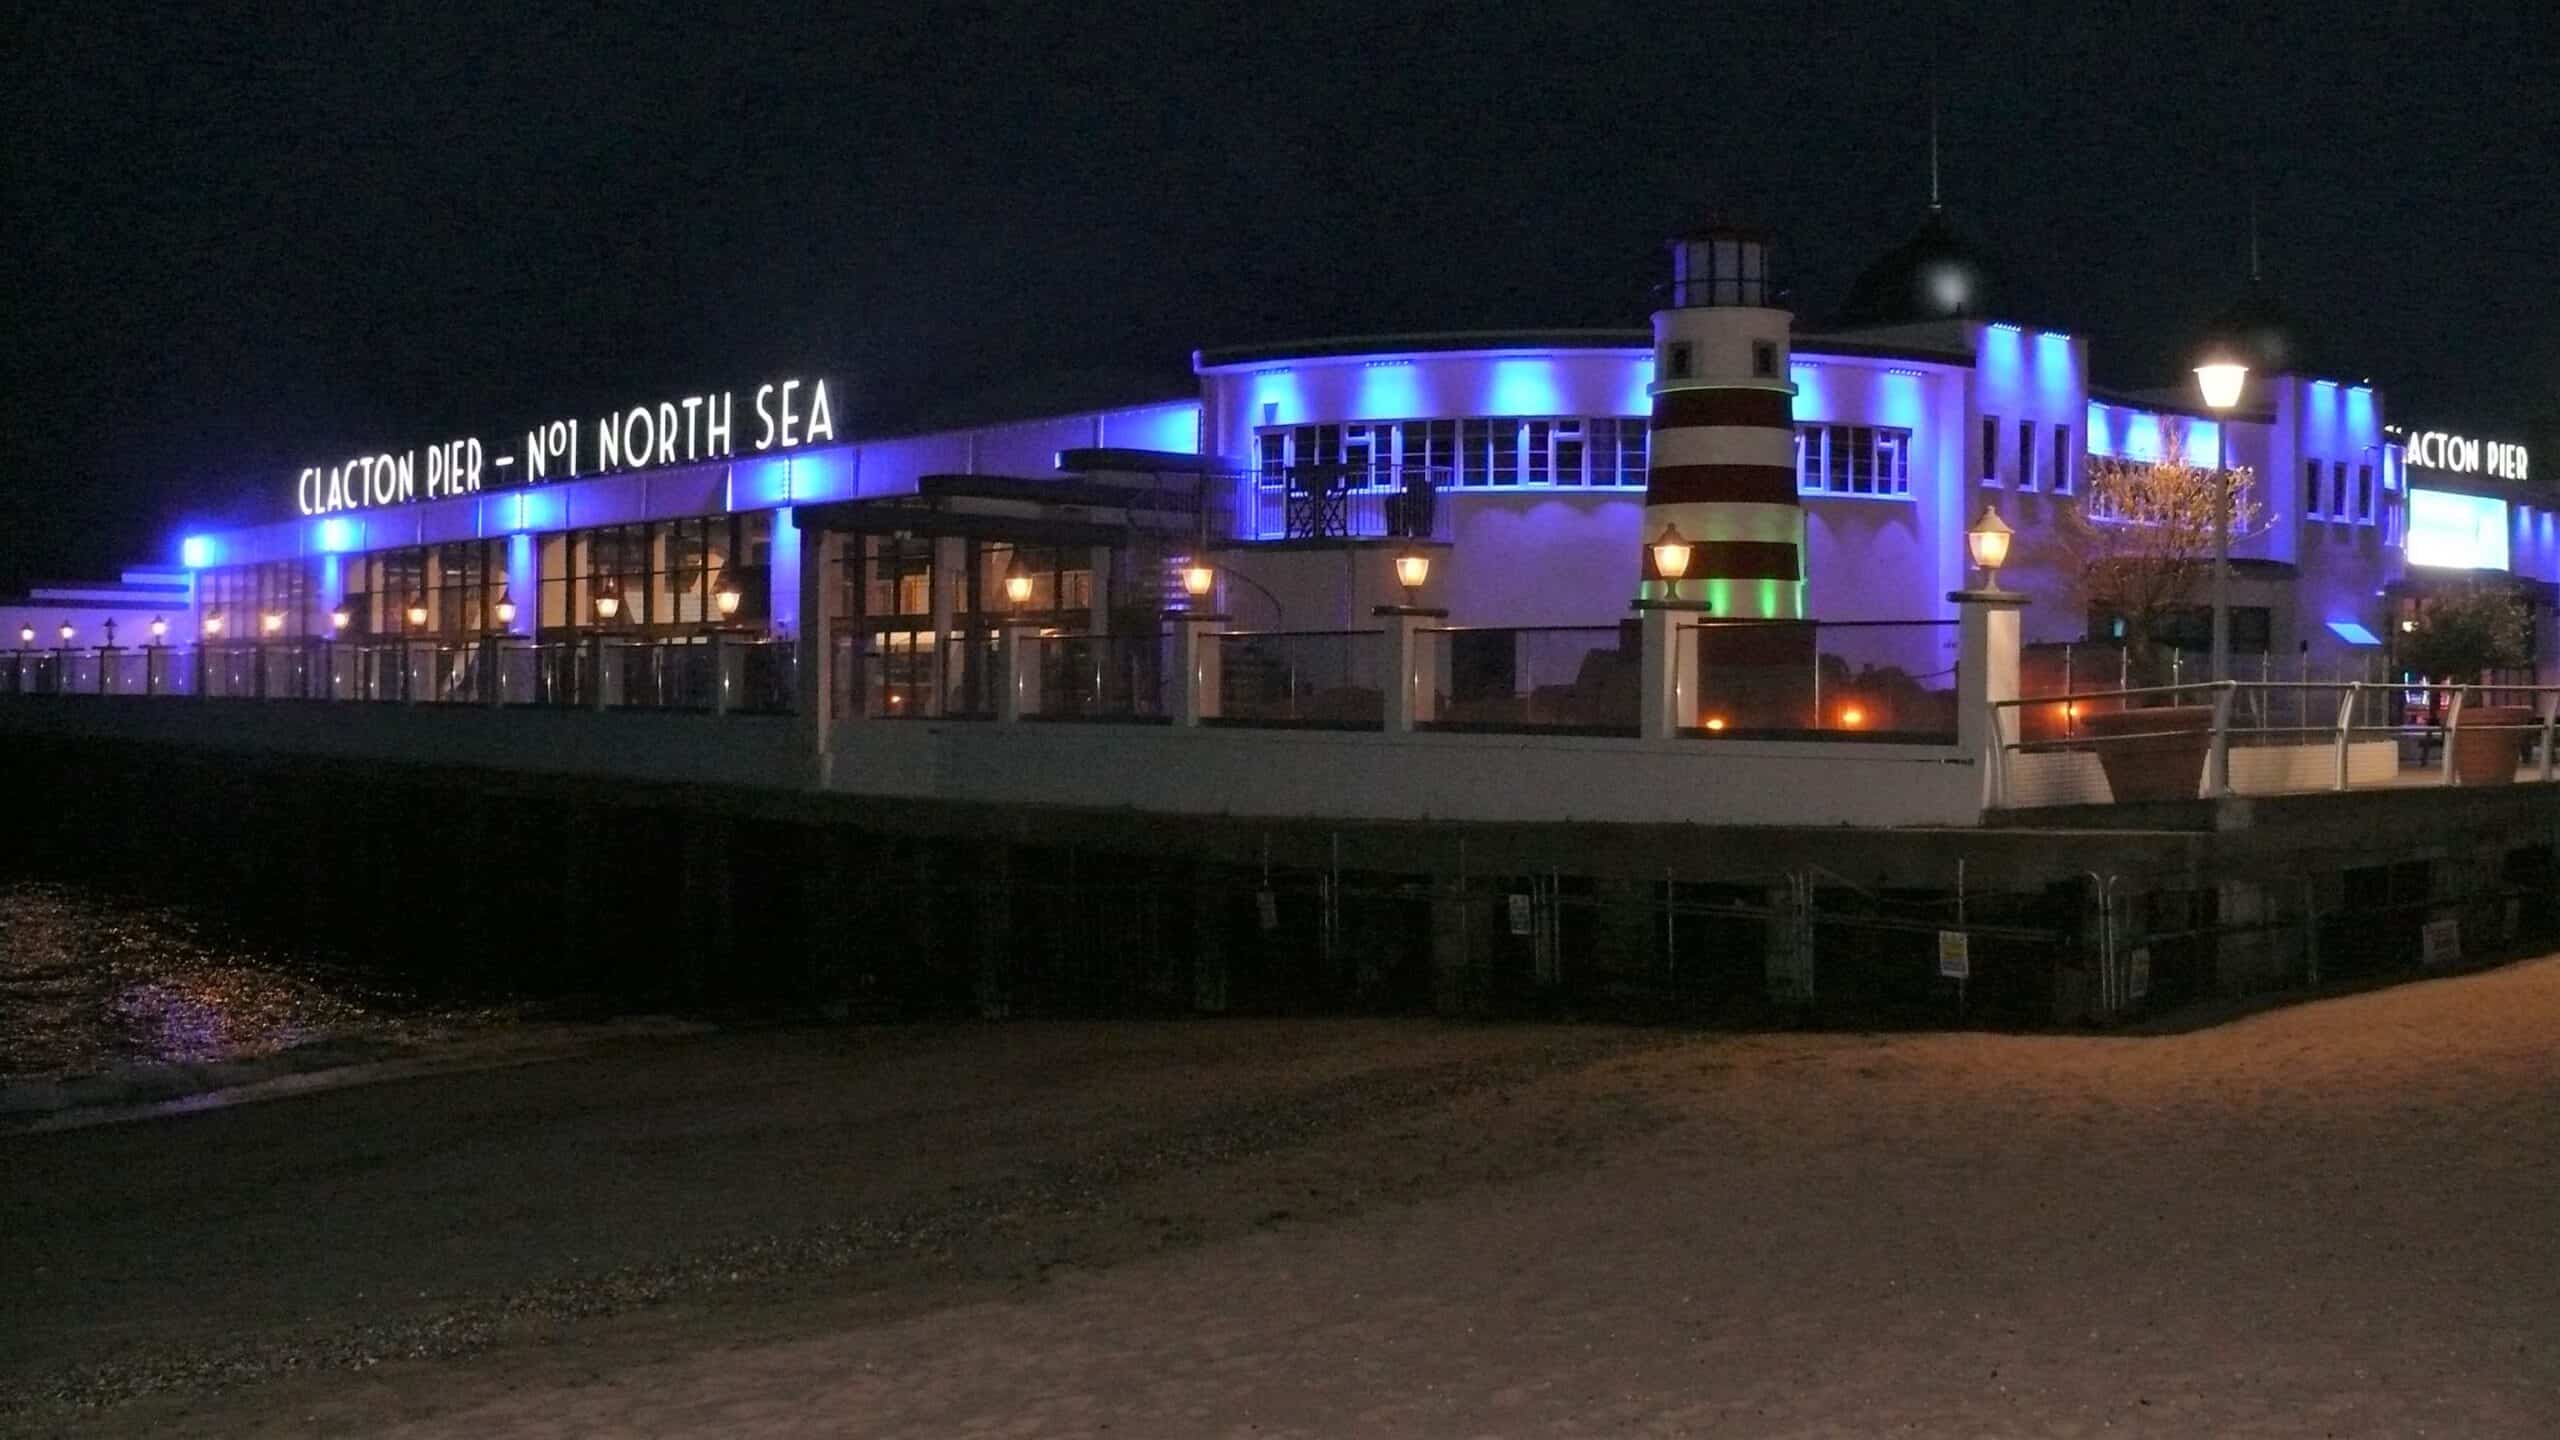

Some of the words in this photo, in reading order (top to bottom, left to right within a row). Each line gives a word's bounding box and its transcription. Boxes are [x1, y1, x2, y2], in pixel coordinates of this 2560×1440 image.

[298, 450, 415, 516] CLACTON
[427, 437, 483, 496] PIER
[599, 390, 732, 474] NORTH
[755, 378, 834, 450] SEA
[2384, 425, 2480, 473] ACTON
[2486, 440, 2529, 481] PIER
